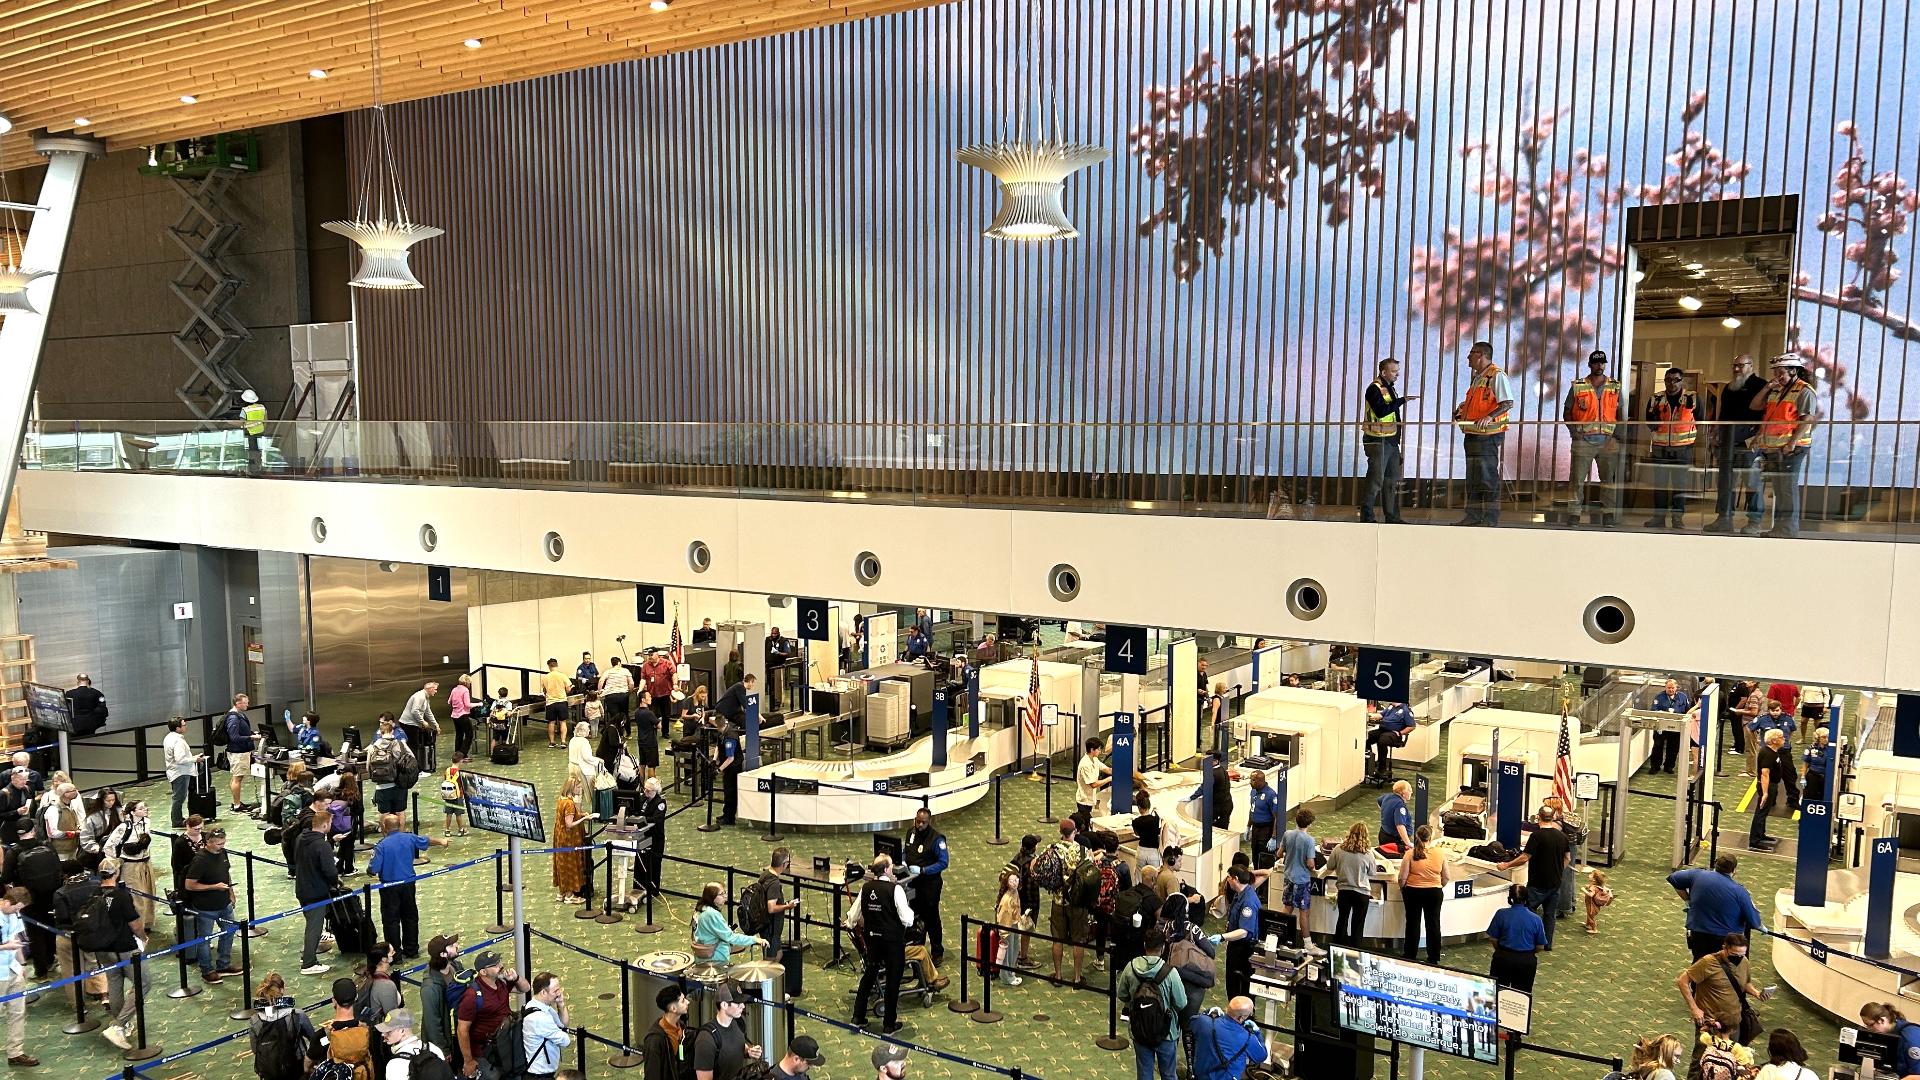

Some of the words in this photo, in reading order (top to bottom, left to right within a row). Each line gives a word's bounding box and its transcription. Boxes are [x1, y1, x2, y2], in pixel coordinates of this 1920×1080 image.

[435, 575, 443, 594] 1
[645, 594, 656, 614] 2
[806, 609, 819, 631] 3
[1117, 638, 1134, 663] 4
[1373, 661, 1393, 690] 5
[748, 696, 757, 706] 3A
[935, 692, 945, 701] 3B
[1117, 714, 1130, 724] 4B
[1116, 736, 1130, 746] 4A
[1503, 765, 1519, 776] 5B
[759, 781, 770, 790] 3A
[875, 782, 887, 791] 3B
[1806, 804, 1826, 816] 6B
[1877, 842, 1893, 854] 6A
[1457, 884, 1471, 895] 5B
[1362, 976, 1404, 994] boarding
[1363, 965, 1396, 979] Please
[1398, 972, 1422, 986] have
[1438, 983, 1458, 994] and
[1379, 1012, 1423, 1030] identidad
[1429, 1014, 1485, 1033] documento
[1364, 1020, 1393, 1034] boleto
[1410, 1032, 1462, 1050] embarque.
